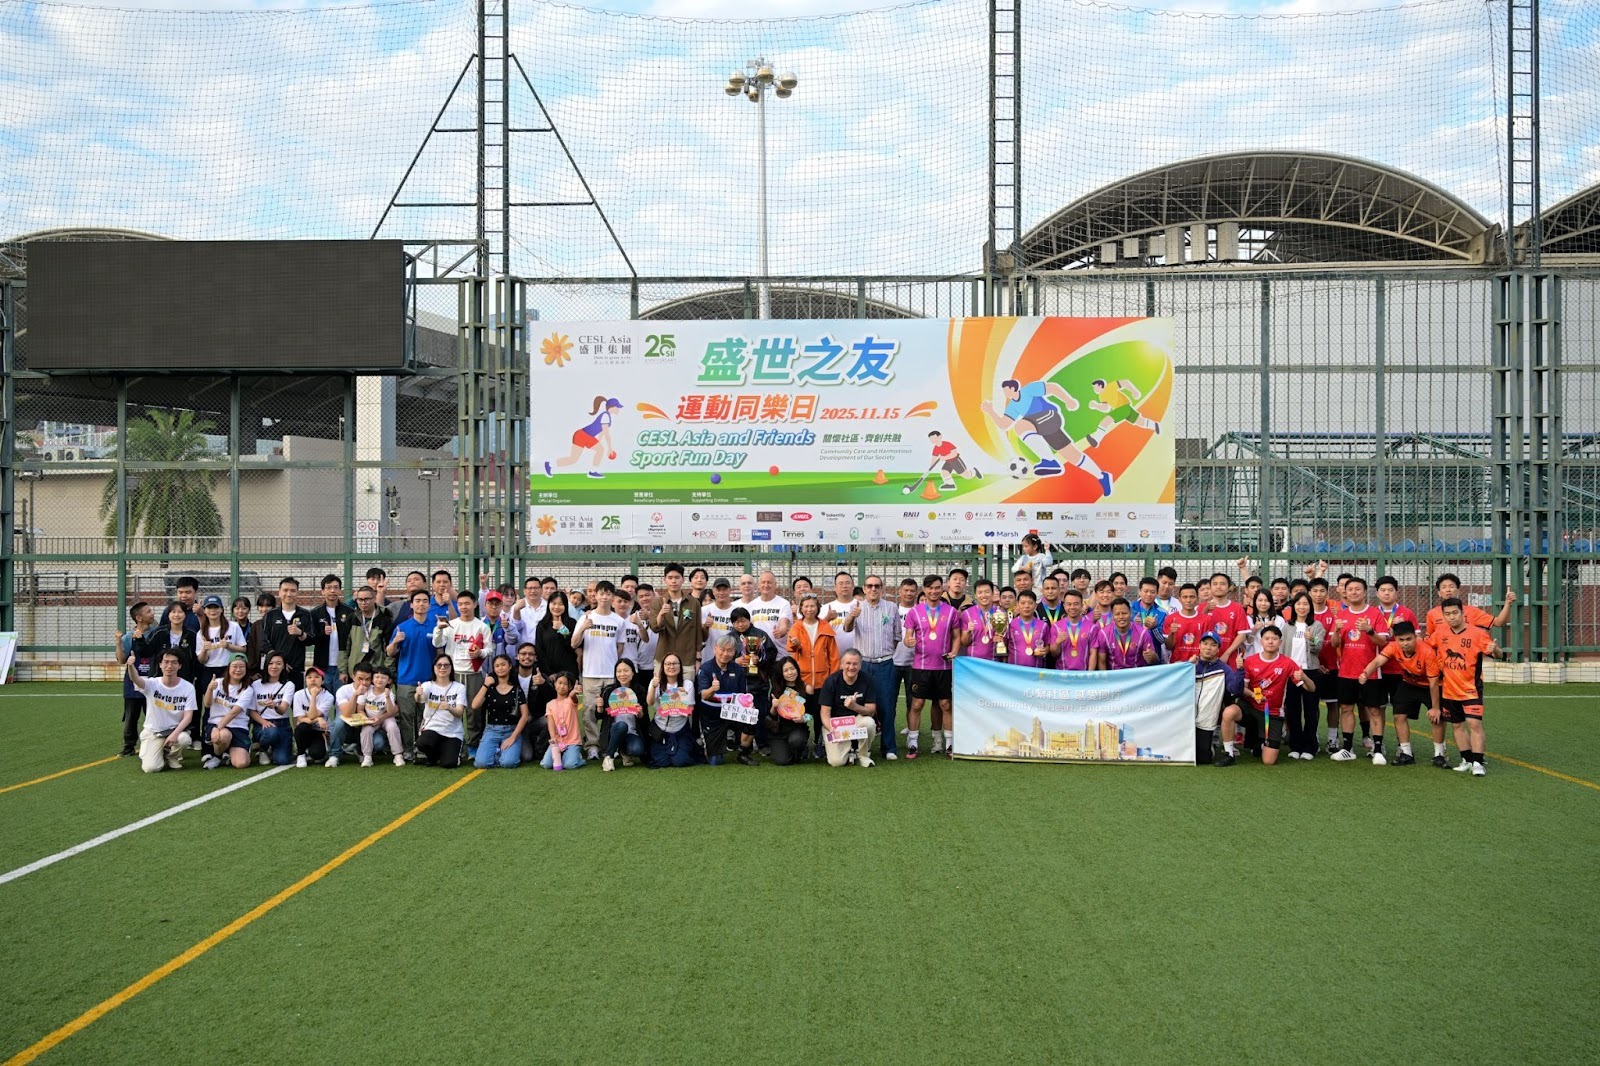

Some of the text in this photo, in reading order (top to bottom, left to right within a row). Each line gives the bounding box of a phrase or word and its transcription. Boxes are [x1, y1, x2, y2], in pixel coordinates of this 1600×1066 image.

[578, 335, 632, 344] CESL Asia
[644, 334, 677, 357] 25
[579, 344, 632, 355] 盛世集團
[697, 336, 896, 382] 盛世之友
[675, 393, 816, 421] 運動同樂日
[819, 407, 902, 420] 2025.11.15
[637, 429, 816, 446] CESL Asia and Friends
[629, 450, 748, 470] Sport Fun Day
[601, 515, 621, 530] 25
[783, 530, 805, 538] Times
[1229, 611, 1235, 620] 2
[1325, 617, 1333, 625] 17
[1460, 638, 1472, 648] 98
[1444, 661, 1467, 671] MGM
[172, 695, 187, 704] grow
[977, 698, 1033, 712] Community
[1079, 703, 1124, 714] Empathy
[1136, 702, 1170, 712] Action
[722, 703, 758, 716] CESL Asia
